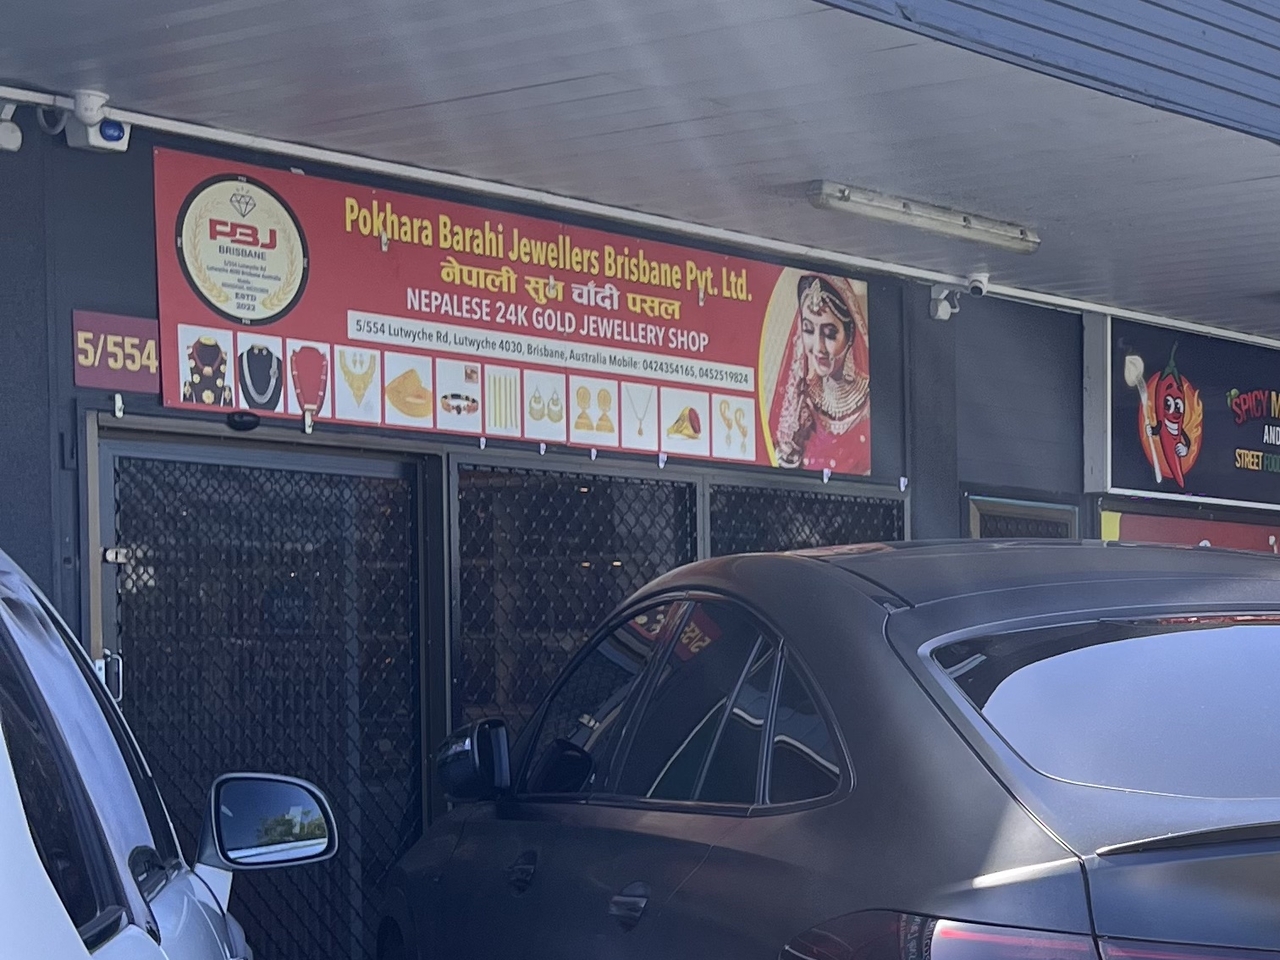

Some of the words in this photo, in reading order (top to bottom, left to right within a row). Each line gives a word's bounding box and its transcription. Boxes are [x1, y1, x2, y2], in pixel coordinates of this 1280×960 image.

[208, 217, 278, 250] PBJ
[218, 244, 268, 261] BRISBANE
[344, 196, 434, 247] Pokhara
[438, 213, 504, 259] Barahi
[507, 227, 600, 277] Jewellers
[604, 244, 682, 291] Brisbane
[722, 266, 753, 303] Ltd.
[440, 256, 518, 294] नेपाली
[571, 279, 620, 311] चाँदी
[626, 292, 682, 320] पसल
[406, 287, 491, 322] NEPALESE
[495, 301, 529, 328] 24K
[532, 308, 576, 335] GOLD
[579, 315, 666, 347] JEWELLERY
[668, 327, 709, 354] SHOP
[77, 329, 160, 375] 5/554
[355, 318, 386, 336] 5/554
[388, 324, 434, 343] Lutwyche
[436, 330, 452, 346] Rd,
[453, 334, 497, 352] Lutwyche
[498, 339, 525, 356] 4030,
[527, 343, 568, 363] Brisbane,
[569, 349, 607, 366] Australia
[609, 354, 641, 371] Mobile:
[642, 359, 698, 380] 0424354165,
[699, 367, 749, 386] 0452519824
[1231, 389, 1270, 425] SPICY
[1235, 448, 1263, 471] STREET
